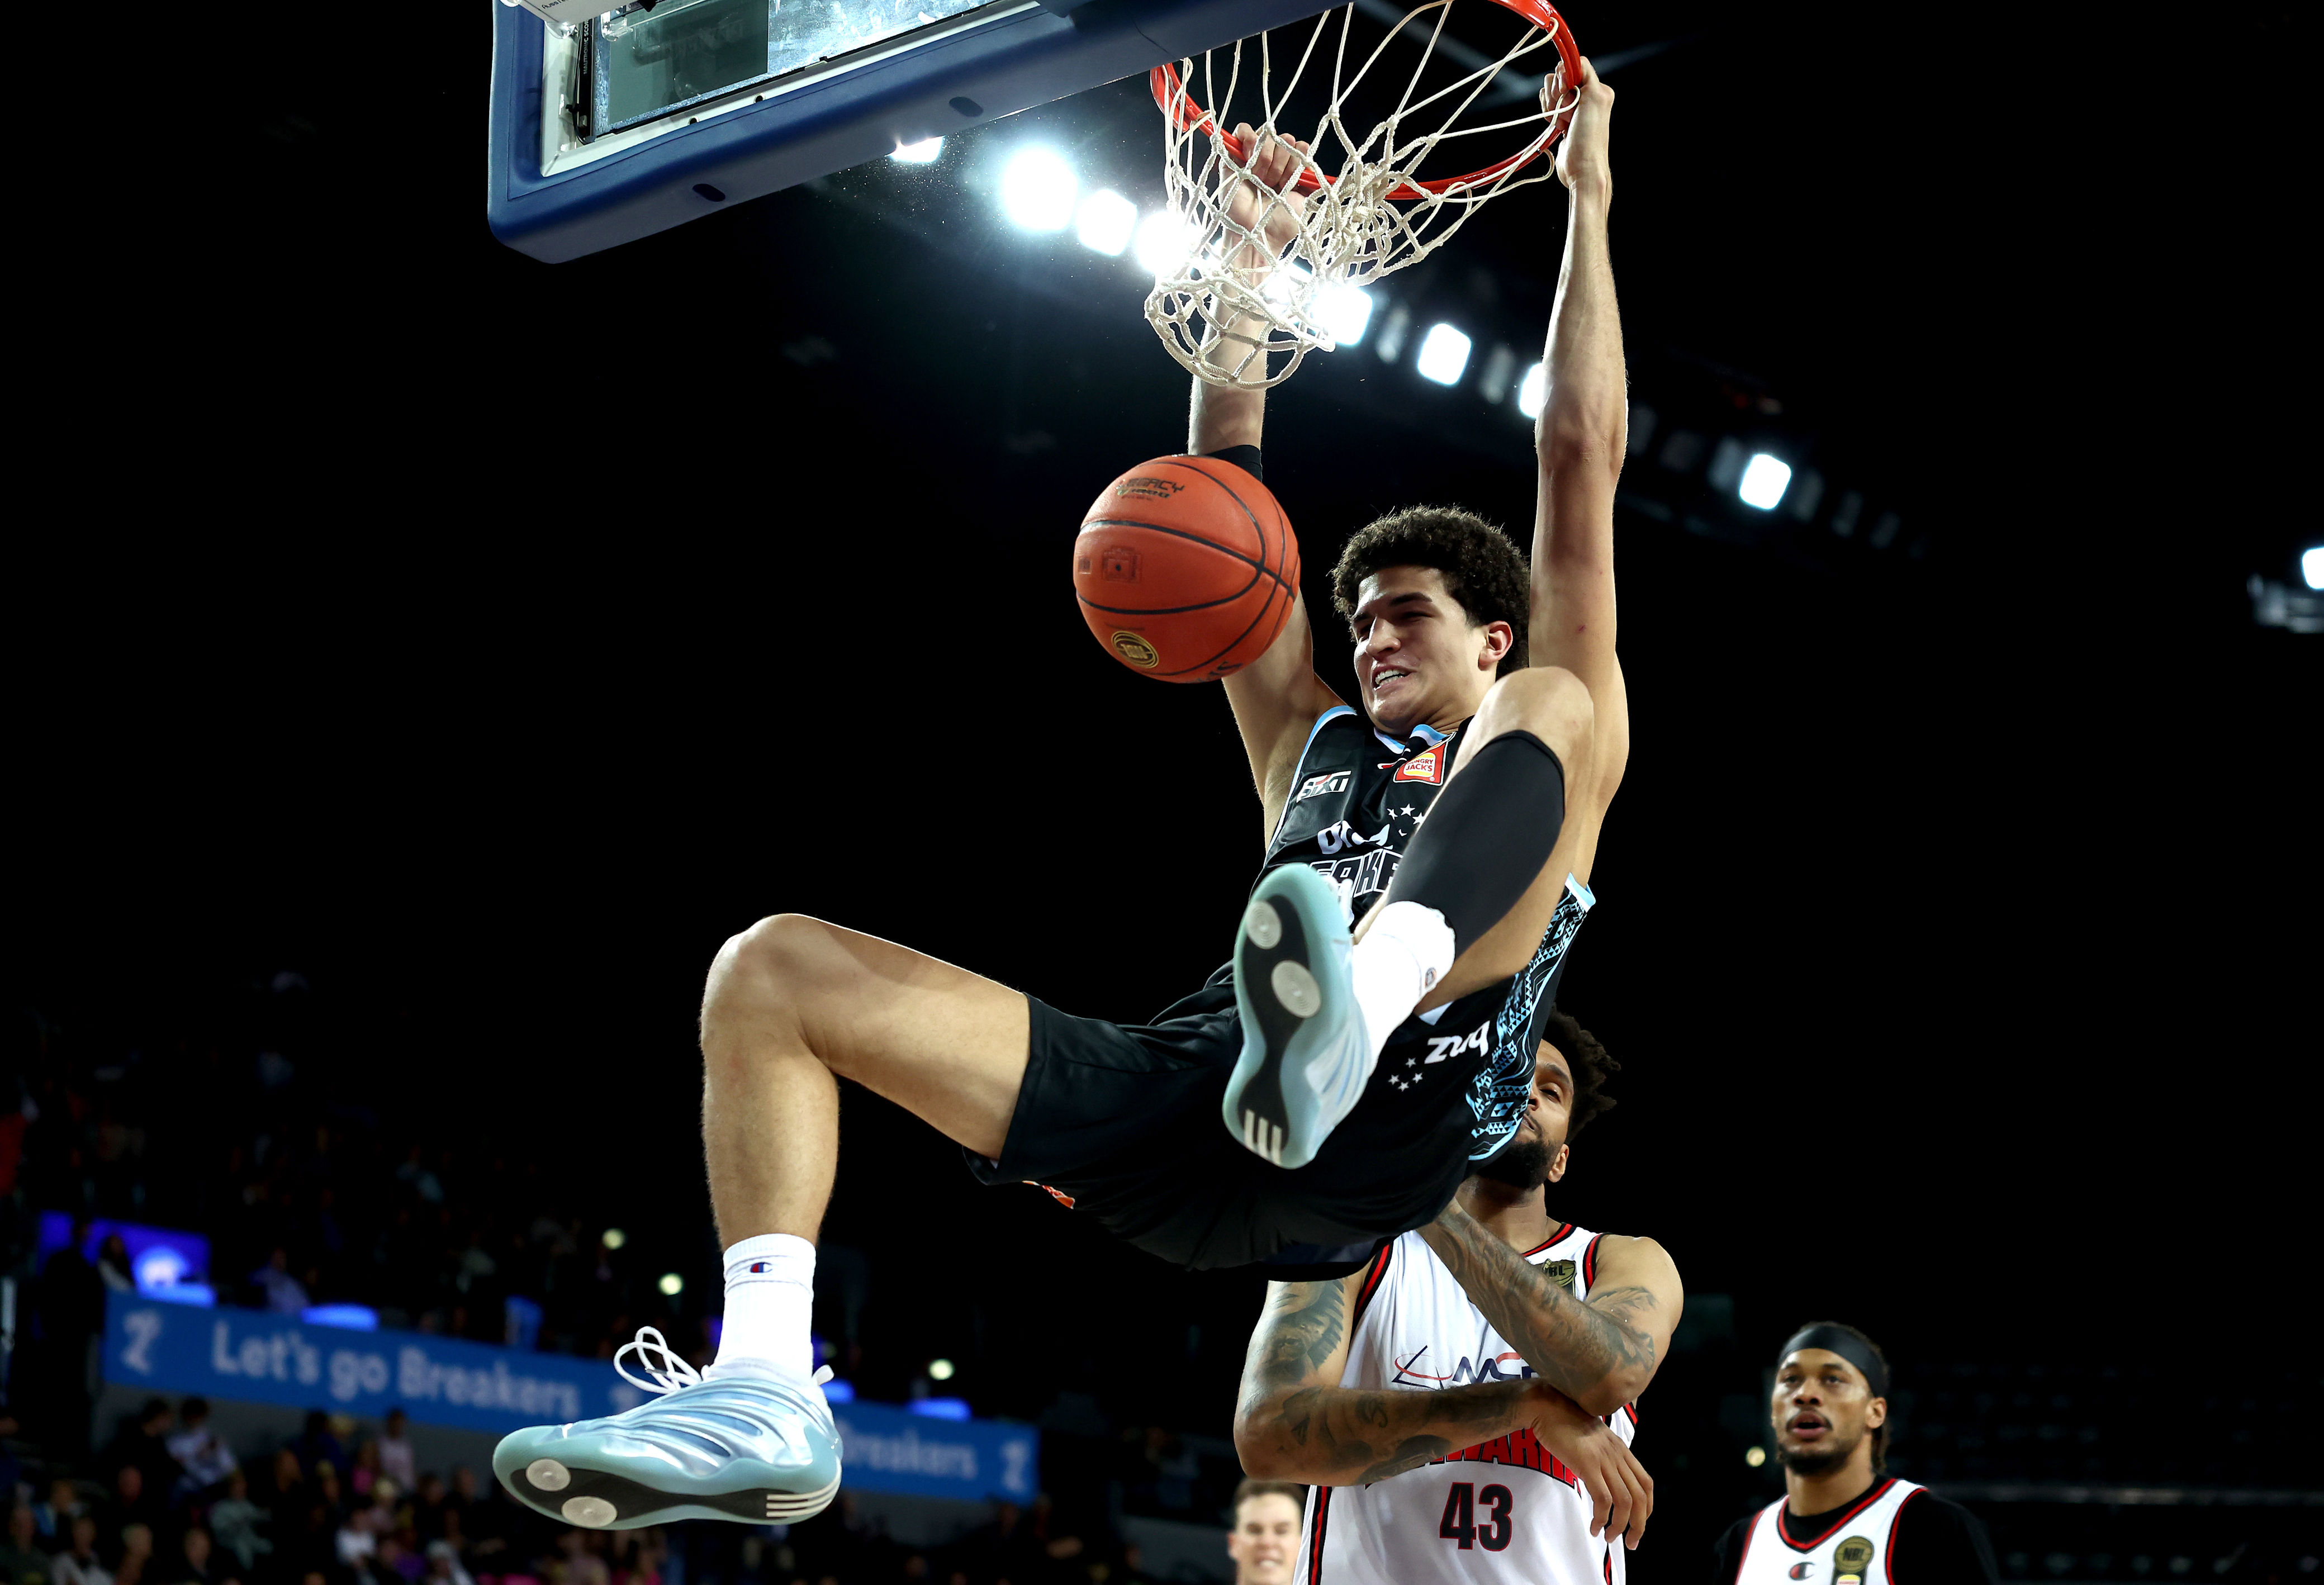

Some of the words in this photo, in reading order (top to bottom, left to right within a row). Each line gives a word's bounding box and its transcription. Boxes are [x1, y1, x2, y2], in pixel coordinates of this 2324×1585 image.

[1300, 775, 1351, 800] SIXT
[1406, 763, 1433, 772] JACK'S
[212, 1318, 320, 1385] Let's
[329, 1349, 388, 1402] go
[398, 1346, 581, 1420] Breakers
[1439, 1482, 1513, 1551] 43
